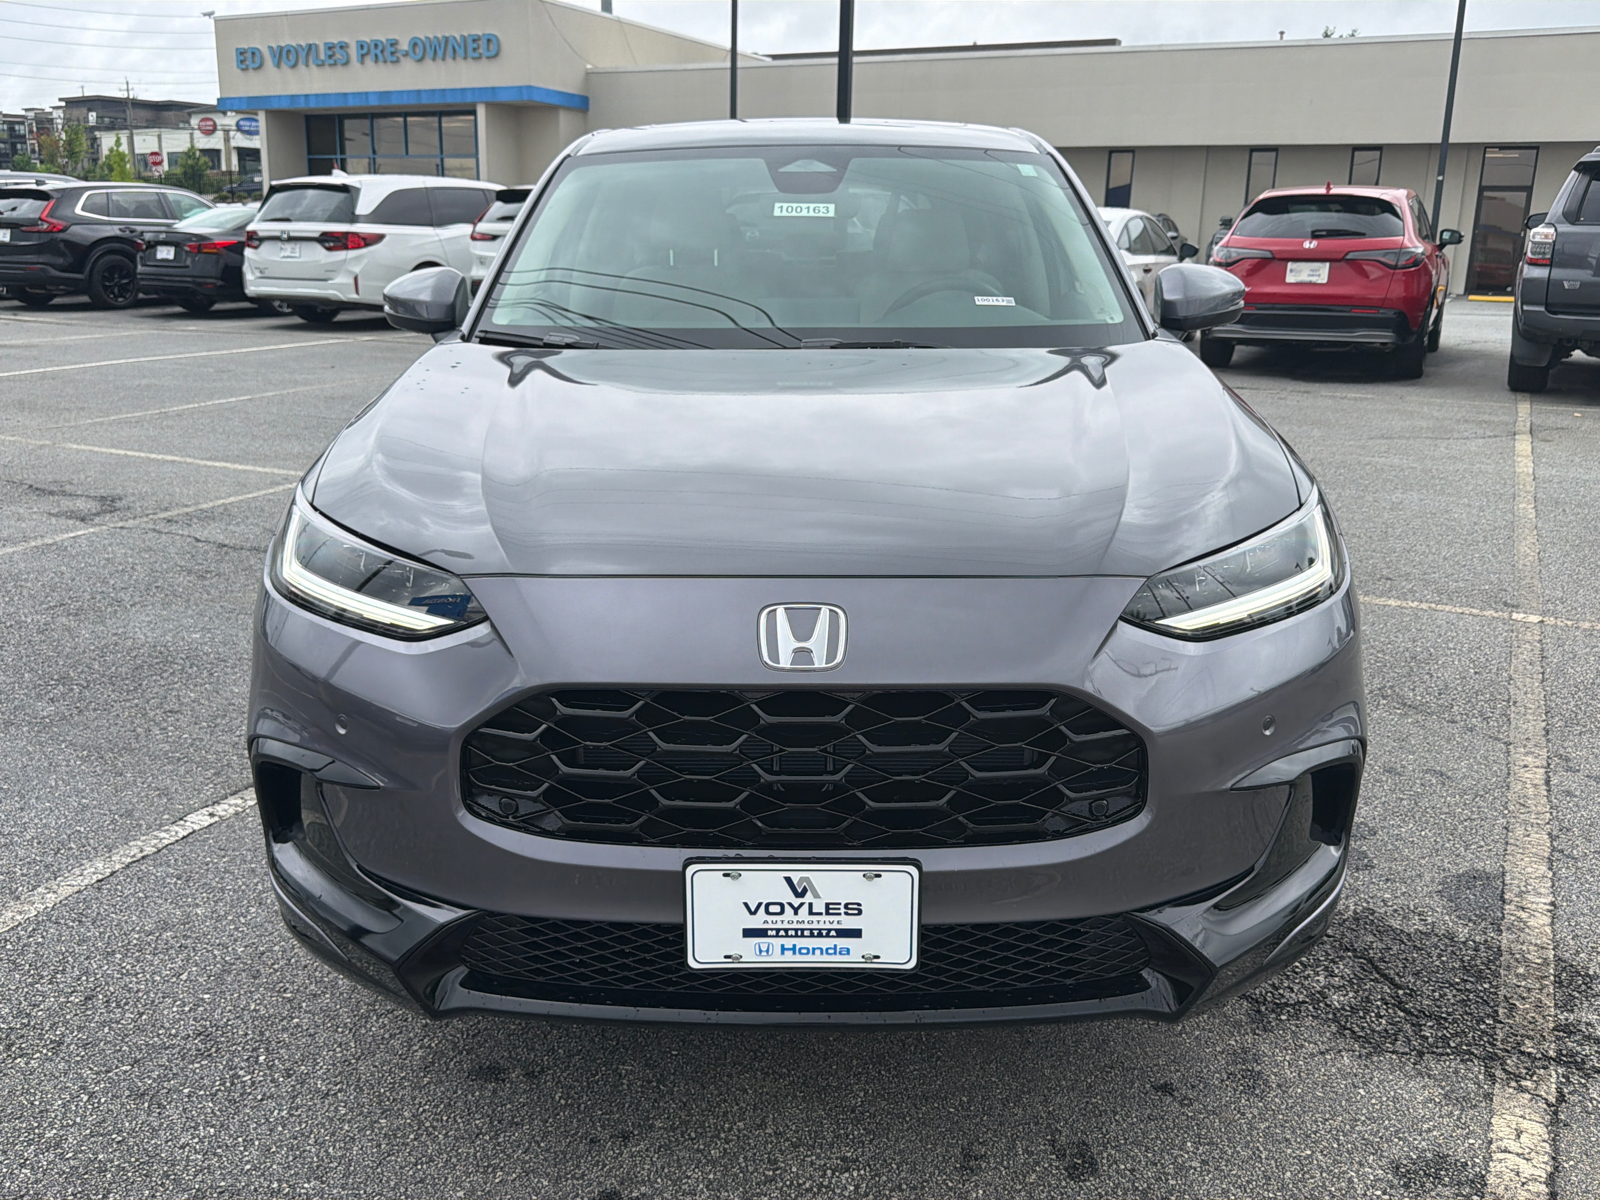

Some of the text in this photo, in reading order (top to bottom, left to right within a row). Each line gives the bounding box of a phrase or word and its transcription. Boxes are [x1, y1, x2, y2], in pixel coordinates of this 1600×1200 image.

[235, 33, 499, 69] ED VOYLES PRE-OWNED
[777, 205, 830, 214] 100163
[742, 902, 863, 916] VOYLES
[780, 944, 851, 956] Honda
